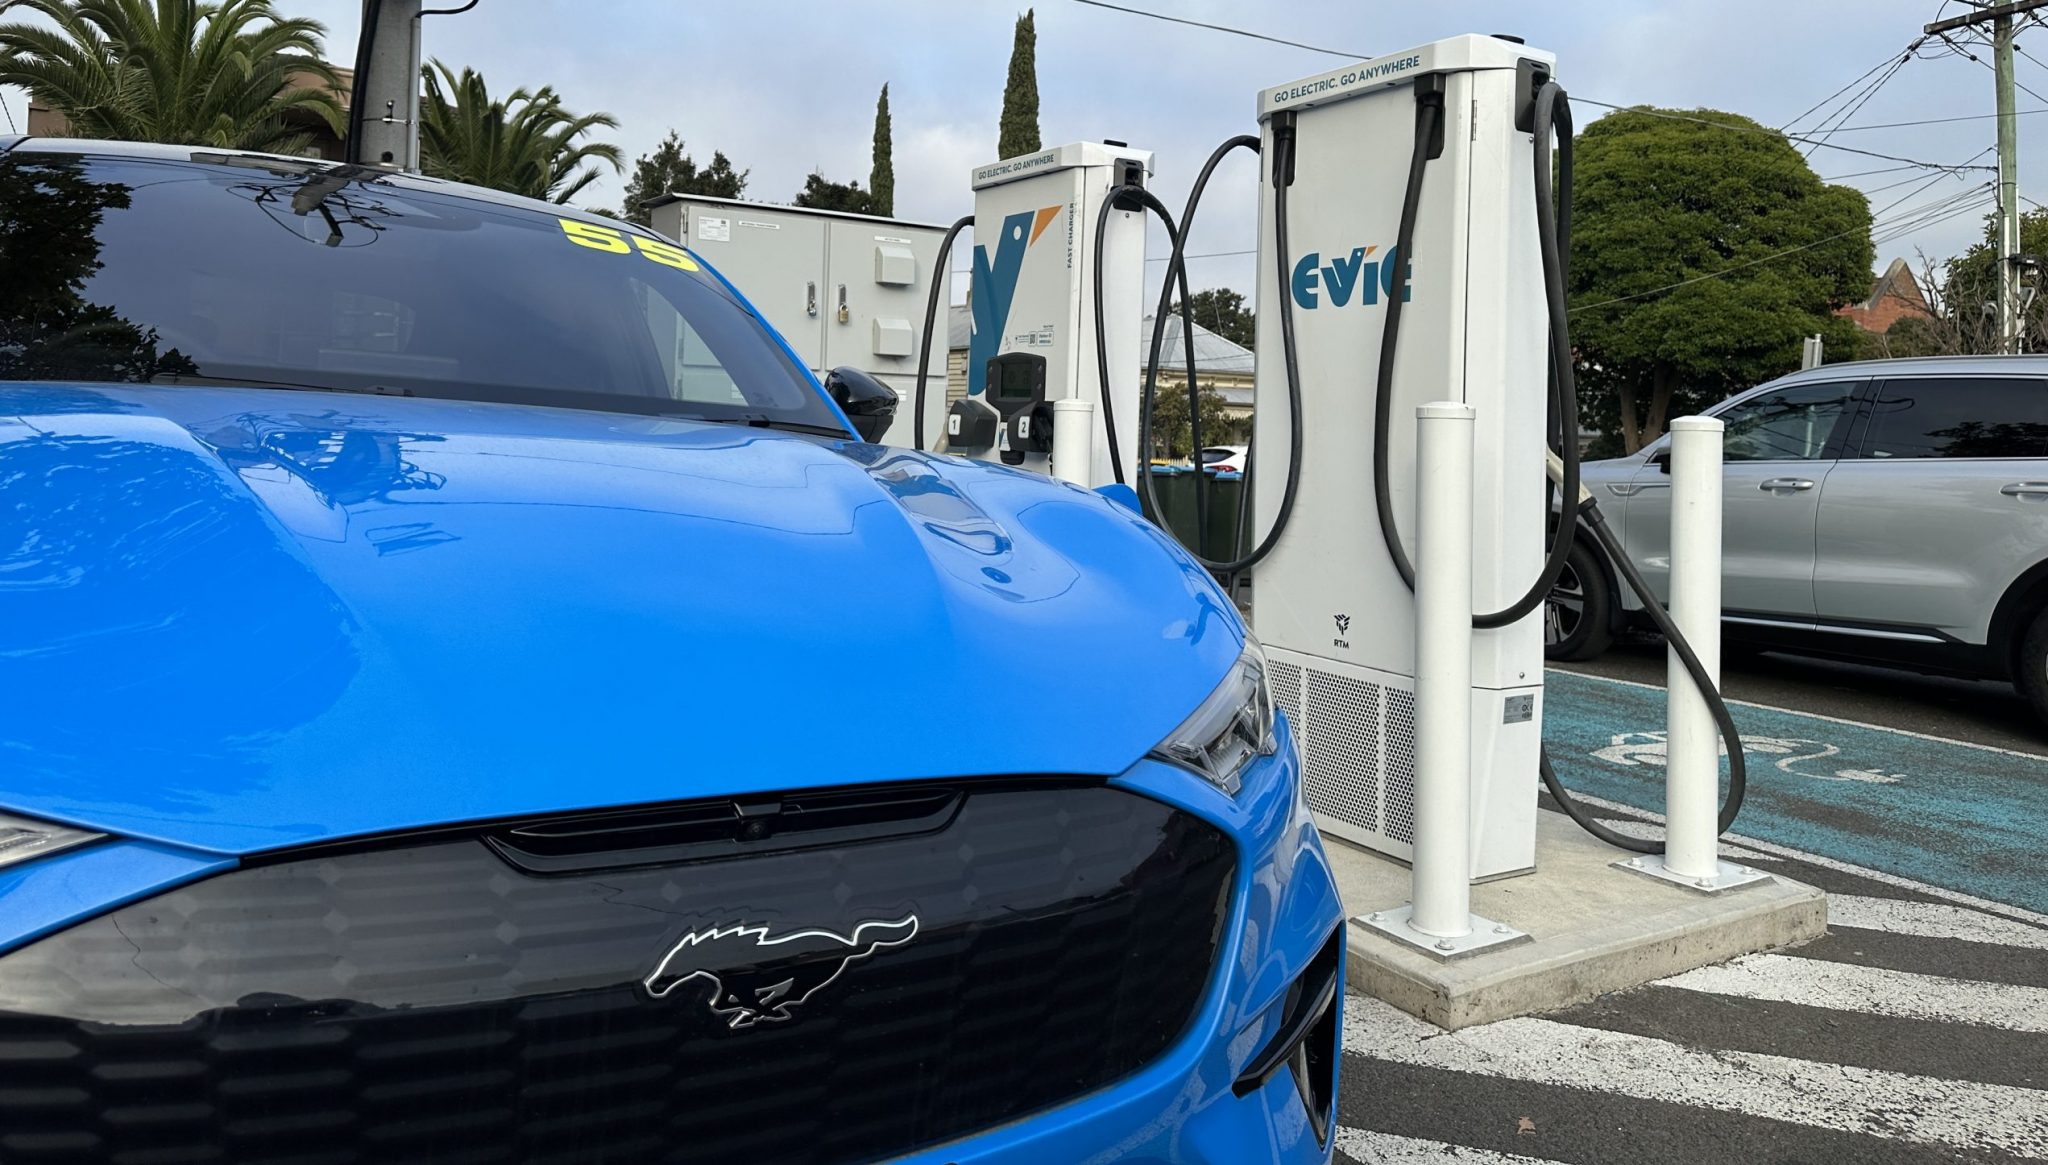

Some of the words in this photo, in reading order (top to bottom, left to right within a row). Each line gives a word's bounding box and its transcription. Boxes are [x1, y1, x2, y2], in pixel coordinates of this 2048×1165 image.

[1274, 90, 1289, 103] GO
[1290, 77, 1338, 99] ELECTRIC.
[1340, 72, 1357, 86] GO
[1358, 55, 1420, 82] ANYWHERE
[1022, 153, 1055, 169] ANYWHERE
[558, 218, 700, 272] 55
[952, 419, 957, 430] 1
[1021, 421, 1026, 433] 2
[1333, 638, 1349, 649] RTM
